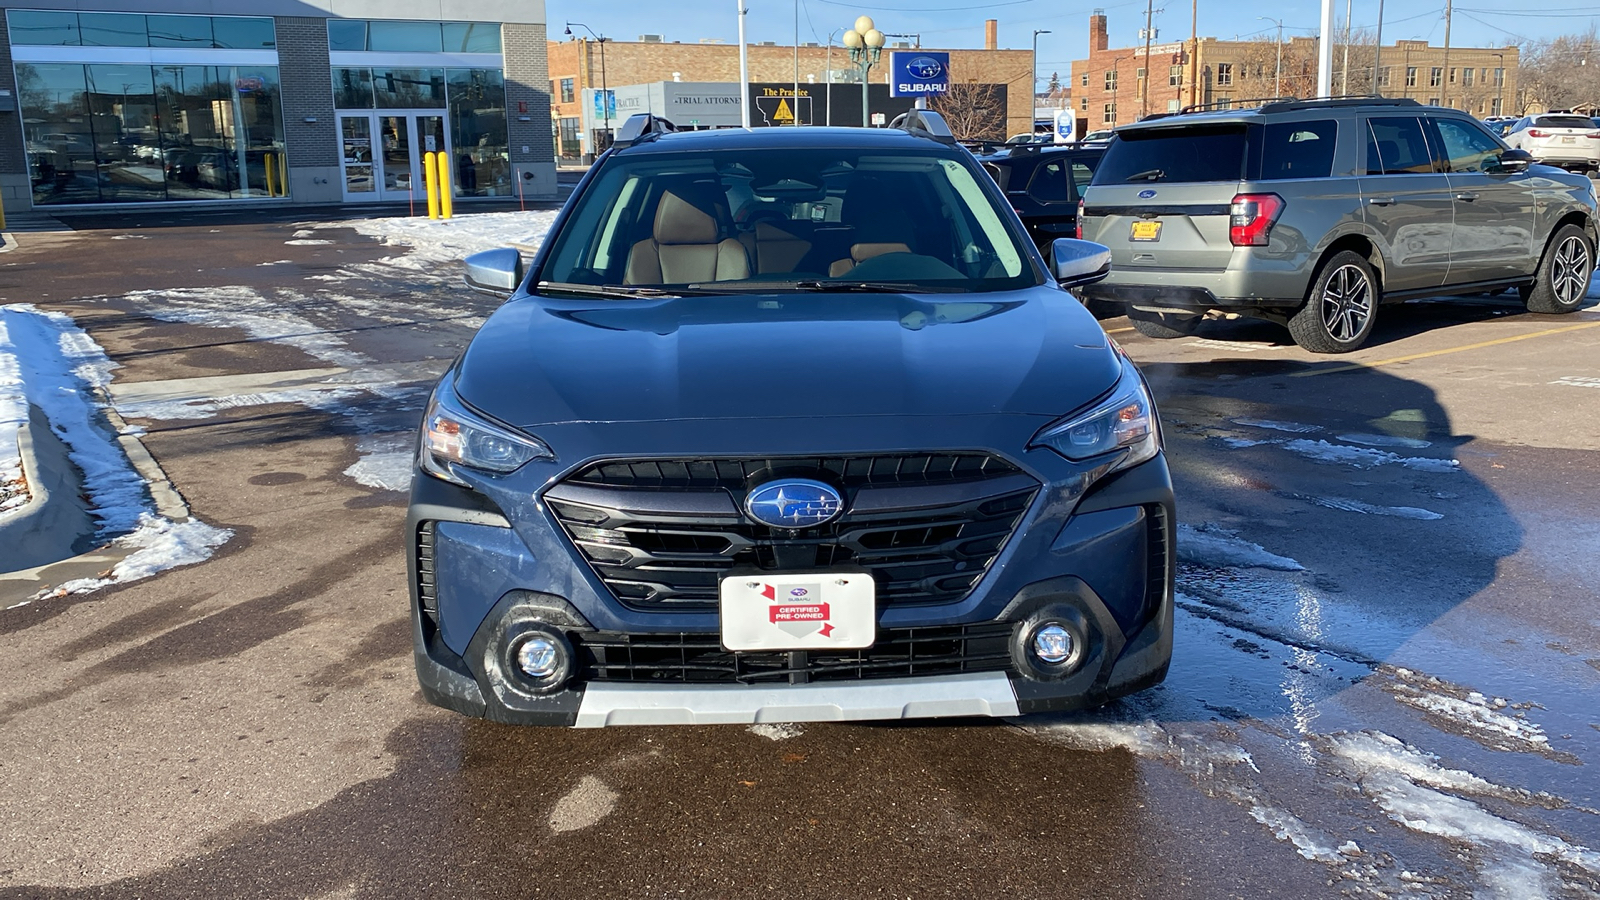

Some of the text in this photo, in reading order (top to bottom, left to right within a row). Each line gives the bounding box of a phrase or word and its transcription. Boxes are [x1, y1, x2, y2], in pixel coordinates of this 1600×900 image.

[763, 88, 808, 96] The Pracice
[899, 83, 946, 92] SUBARU
[616, 98, 640, 108] PRACTICE
